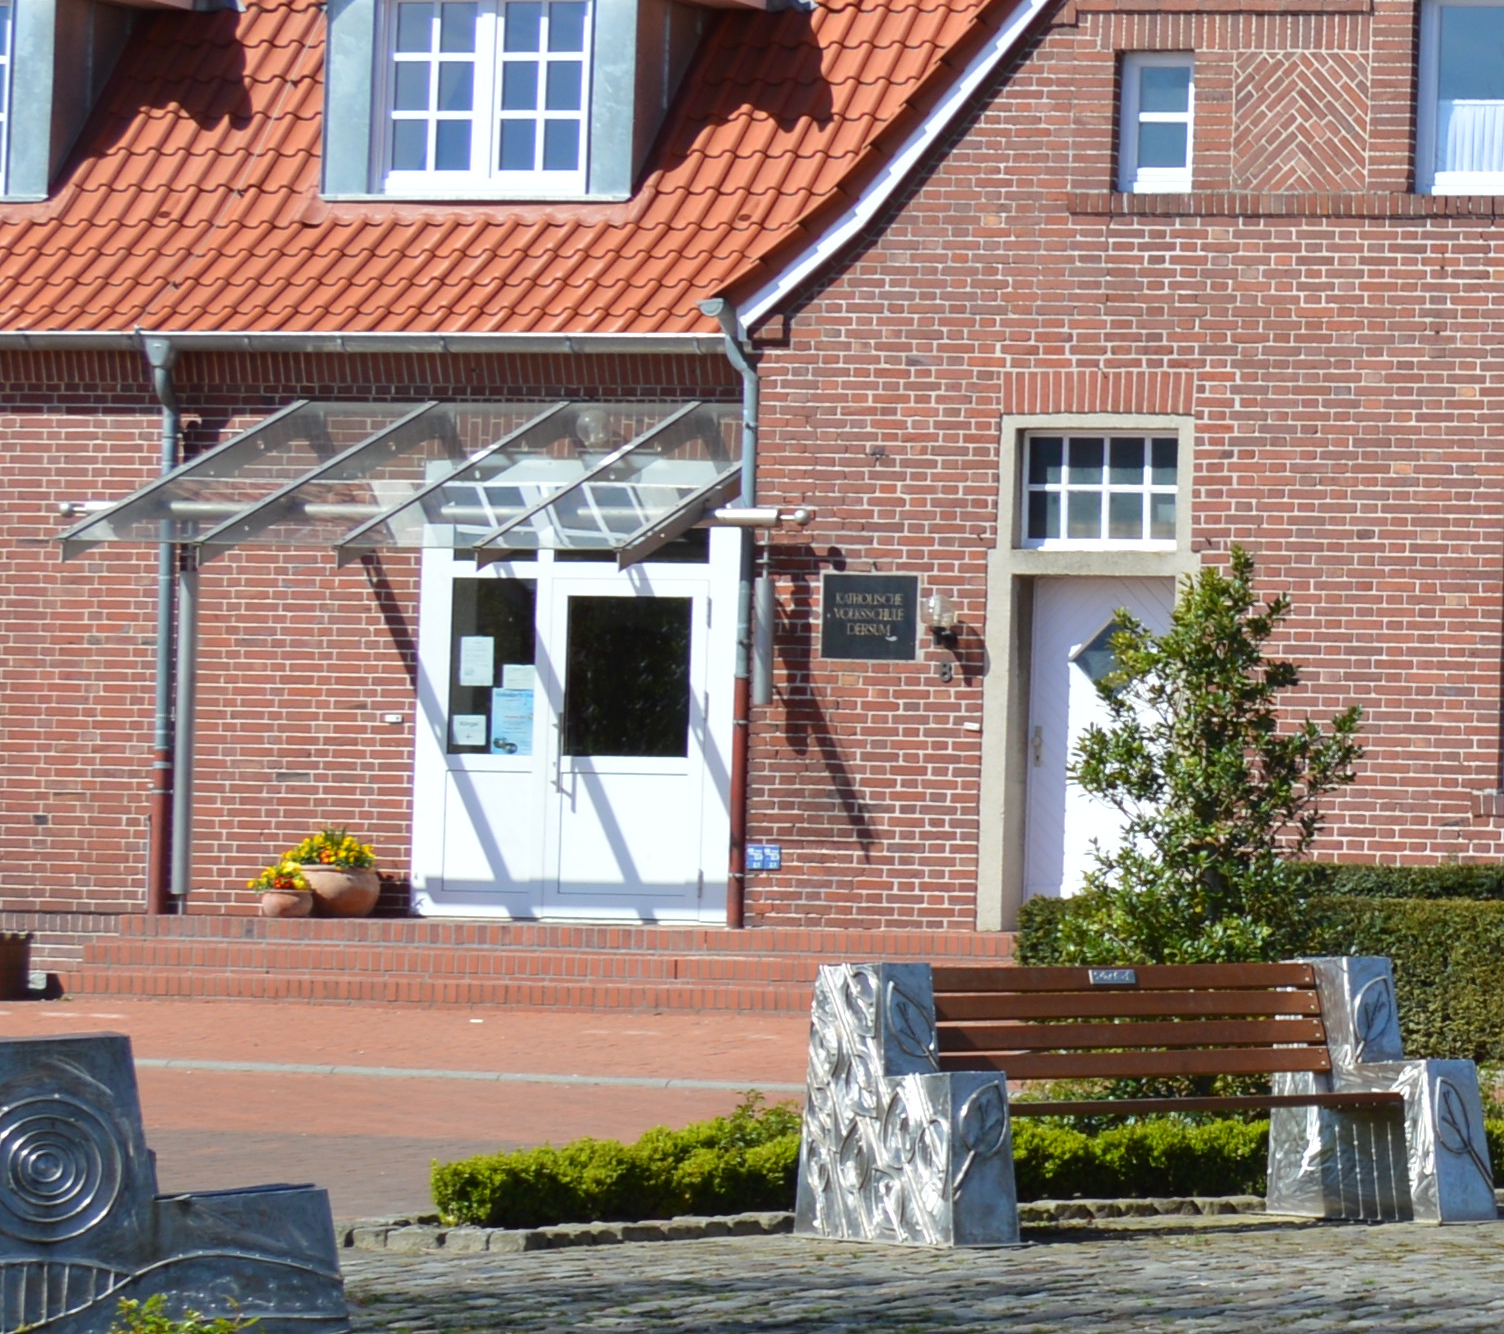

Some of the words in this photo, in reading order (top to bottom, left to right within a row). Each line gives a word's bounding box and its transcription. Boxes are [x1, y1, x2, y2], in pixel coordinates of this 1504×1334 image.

[835, 592, 905, 605] KATHOLISCHE
[833, 607, 905, 621] VOLKSSCHULE
[846, 622, 891, 636] DERSUM
[940, 660, 952, 683] 8
